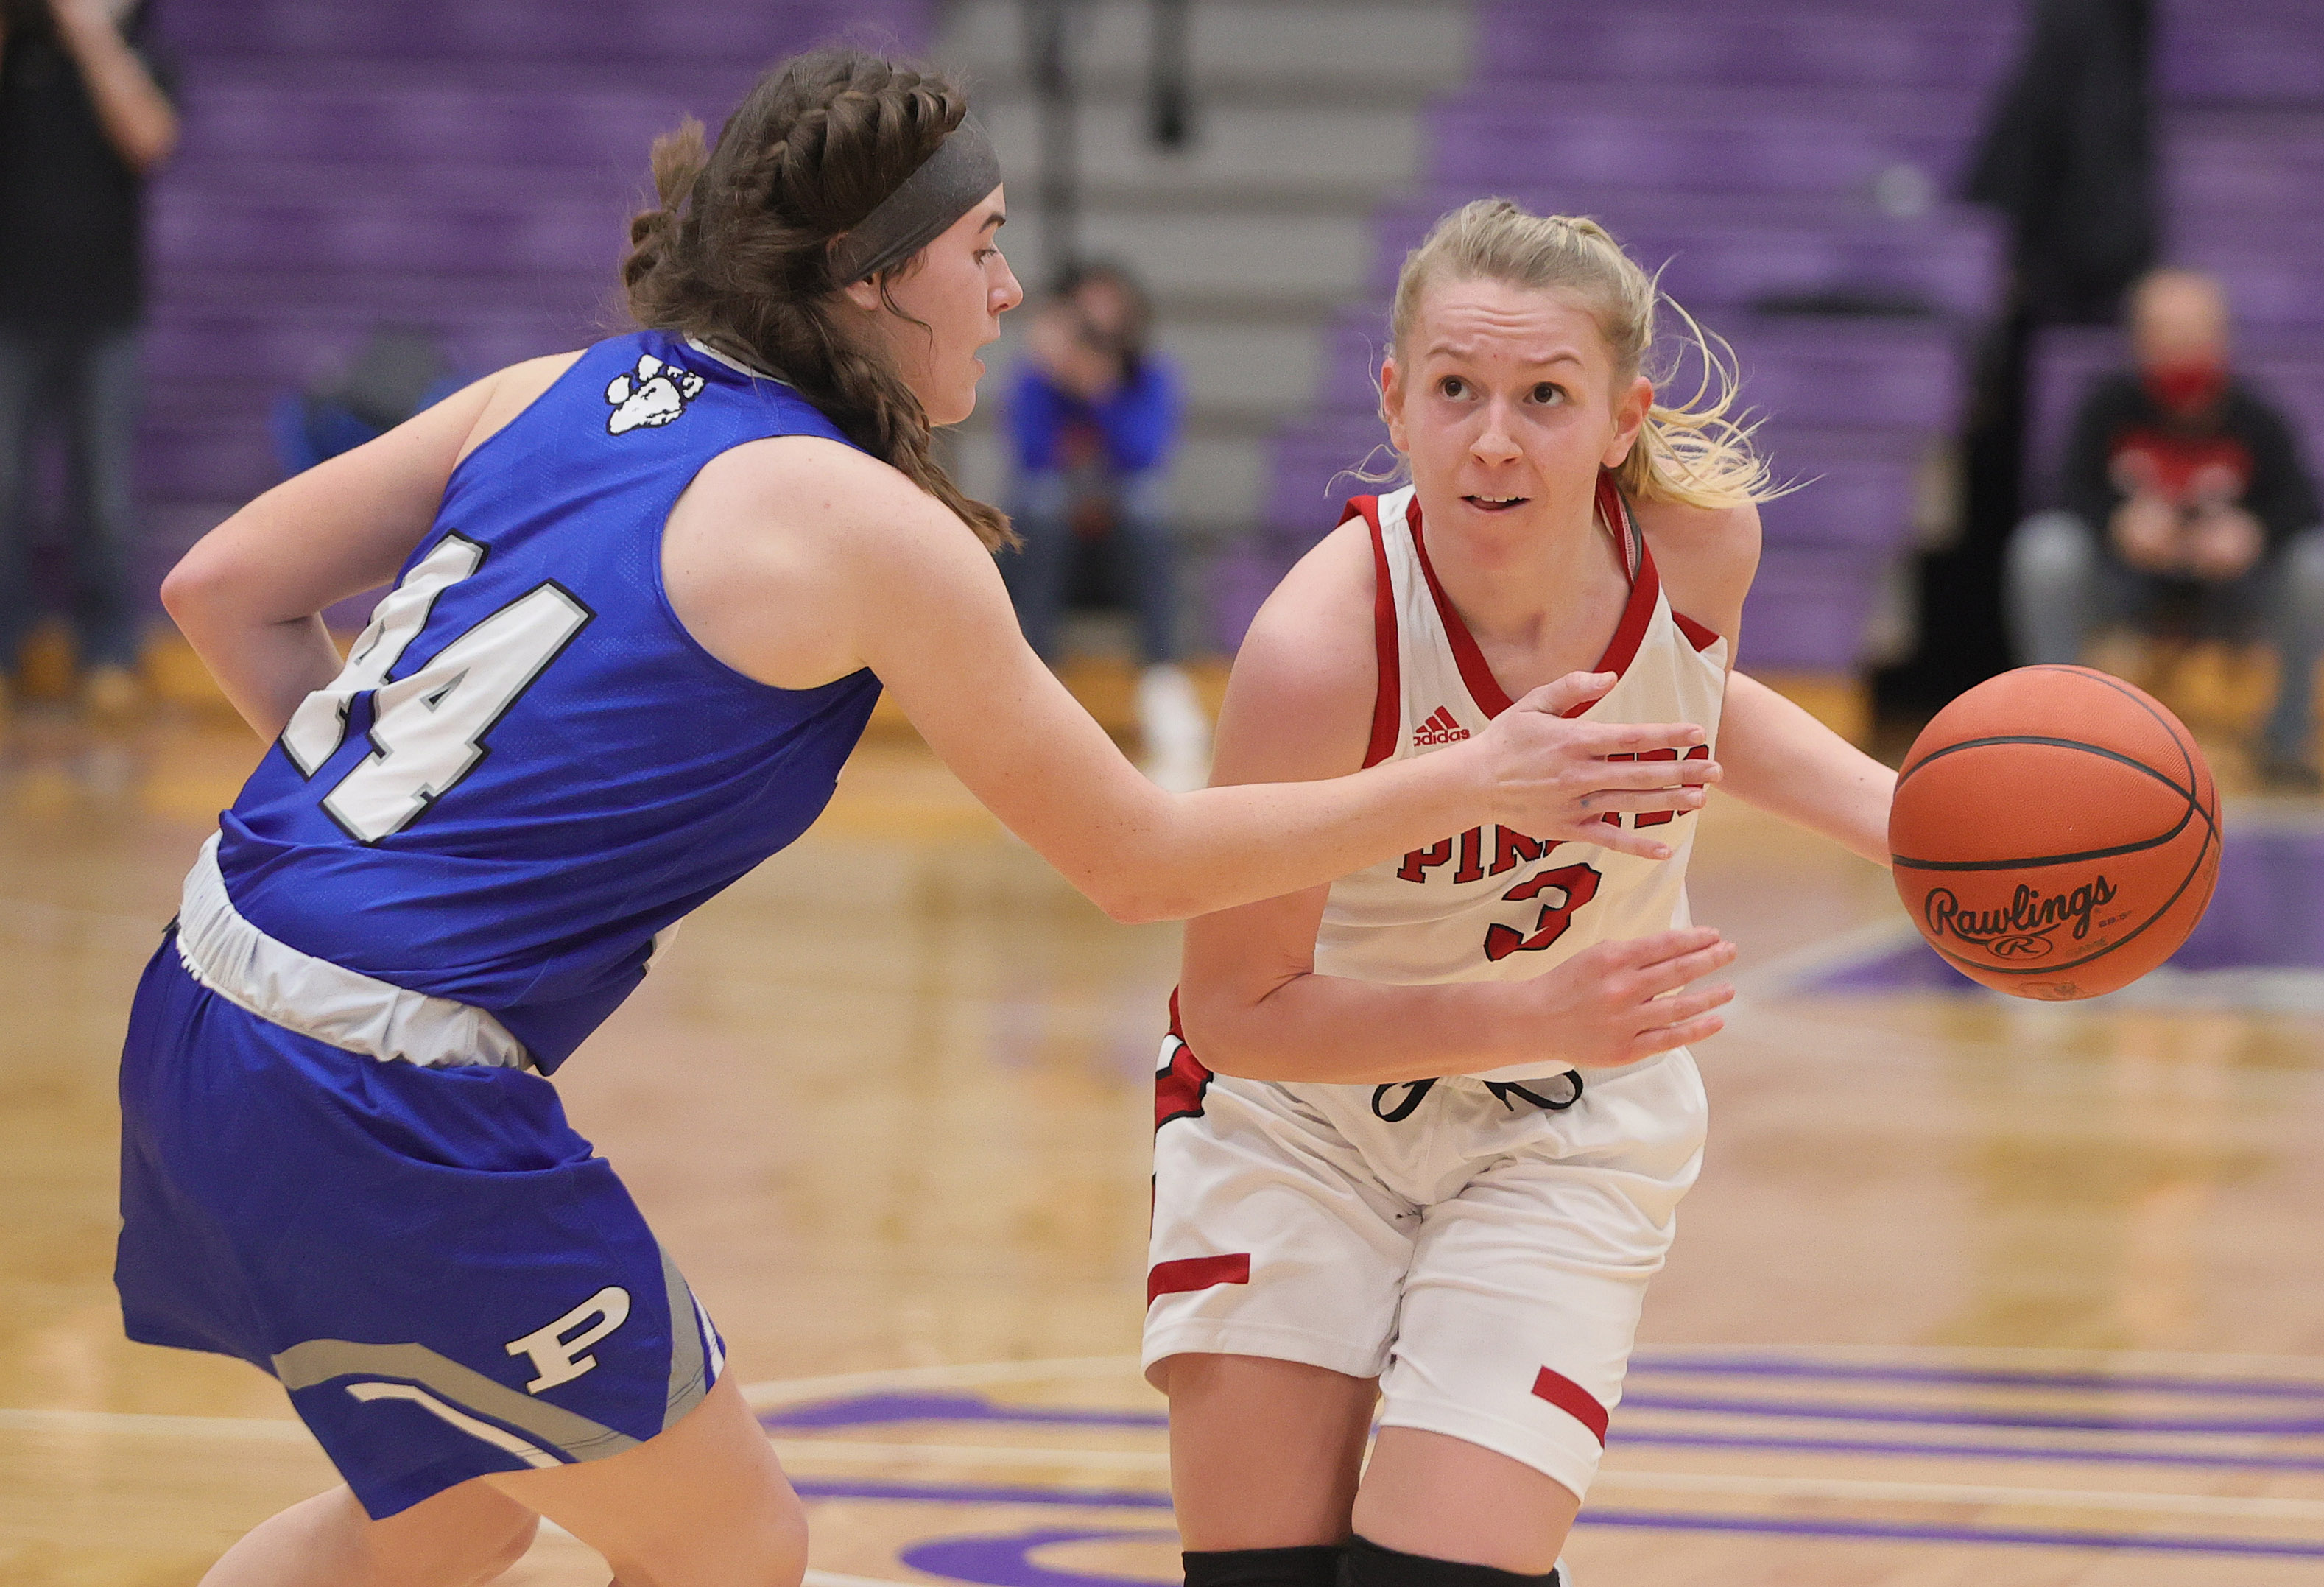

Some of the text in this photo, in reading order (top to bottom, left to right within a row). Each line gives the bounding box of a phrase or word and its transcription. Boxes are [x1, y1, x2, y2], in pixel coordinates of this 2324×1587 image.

[279, 527, 597, 847] 44
[1413, 728, 1471, 747] adidas
[1484, 862, 1602, 962] 3
[1925, 875, 2117, 940] Rawlings
[505, 1285, 631, 1395] P
